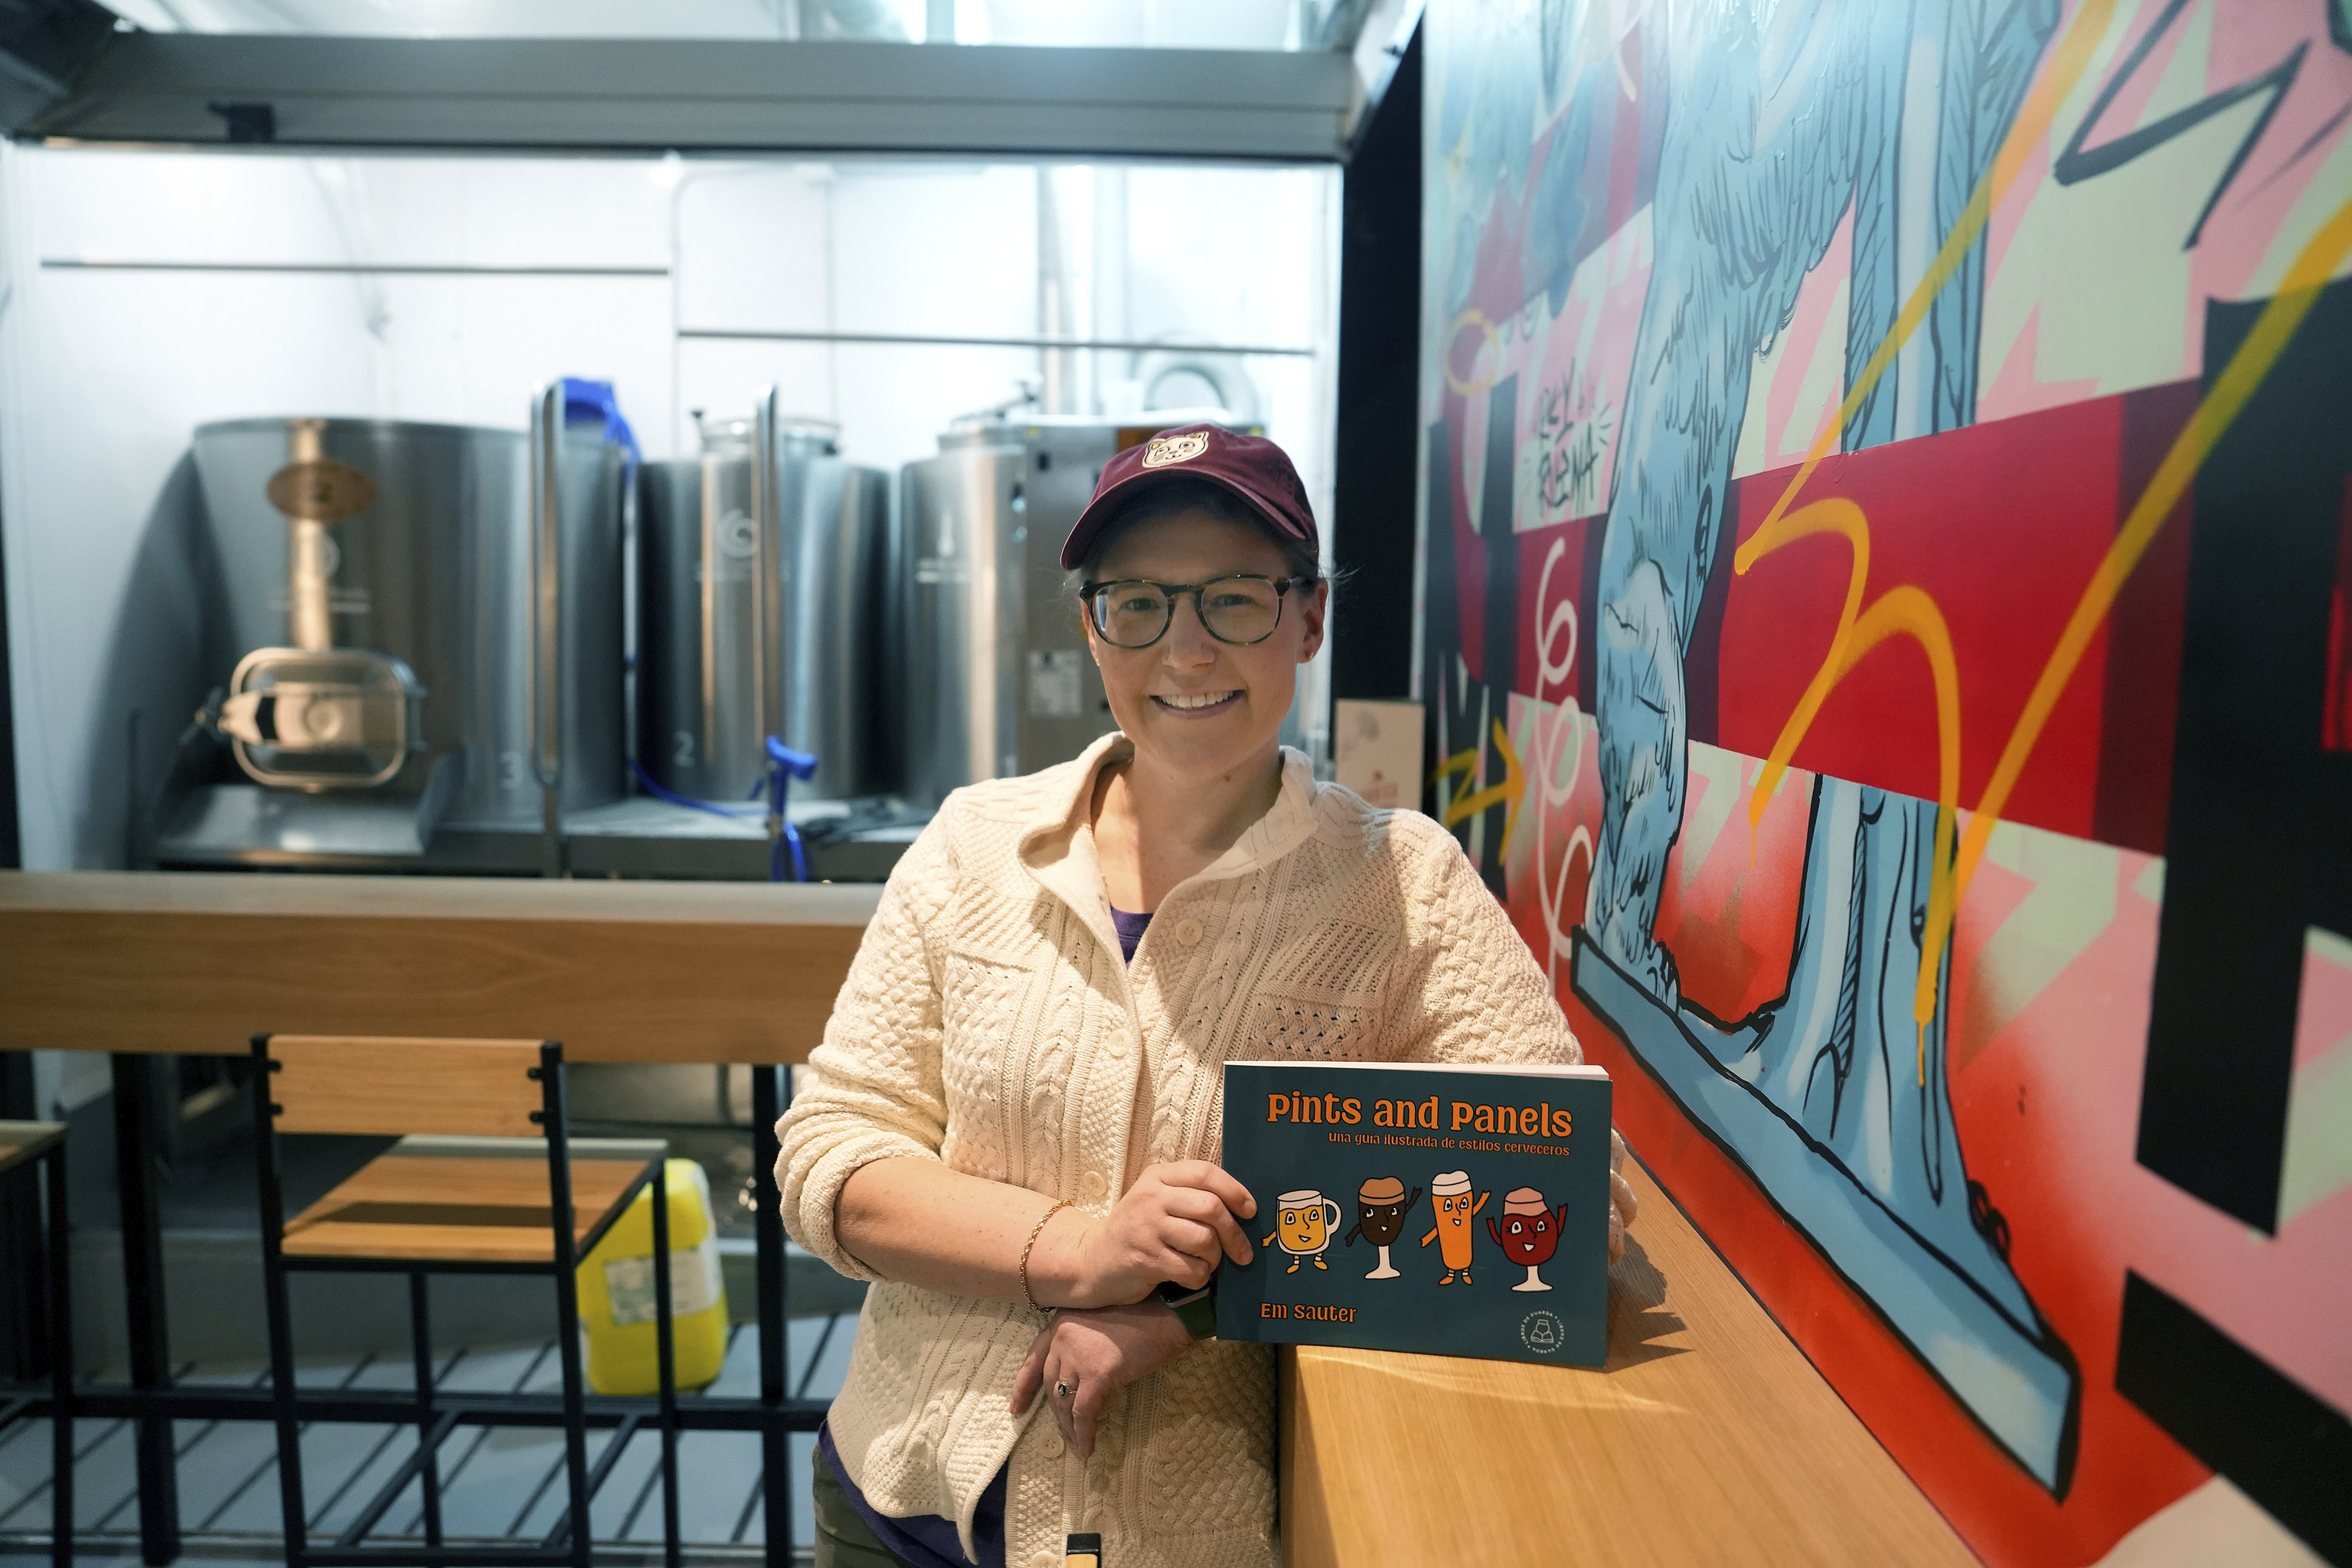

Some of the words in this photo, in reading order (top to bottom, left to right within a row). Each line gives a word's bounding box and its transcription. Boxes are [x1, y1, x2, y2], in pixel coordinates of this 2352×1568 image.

[1373, 1095, 1440, 1129] and
[1328, 1132, 1351, 1143] una
[1383, 1133, 1438, 1148] ilustrada
[1441, 1137, 1455, 1148] de
[1459, 1138, 1501, 1152] estilos
[1504, 1142, 1570, 1156] cerveceros
[1260, 1302, 1287, 1318] Em
